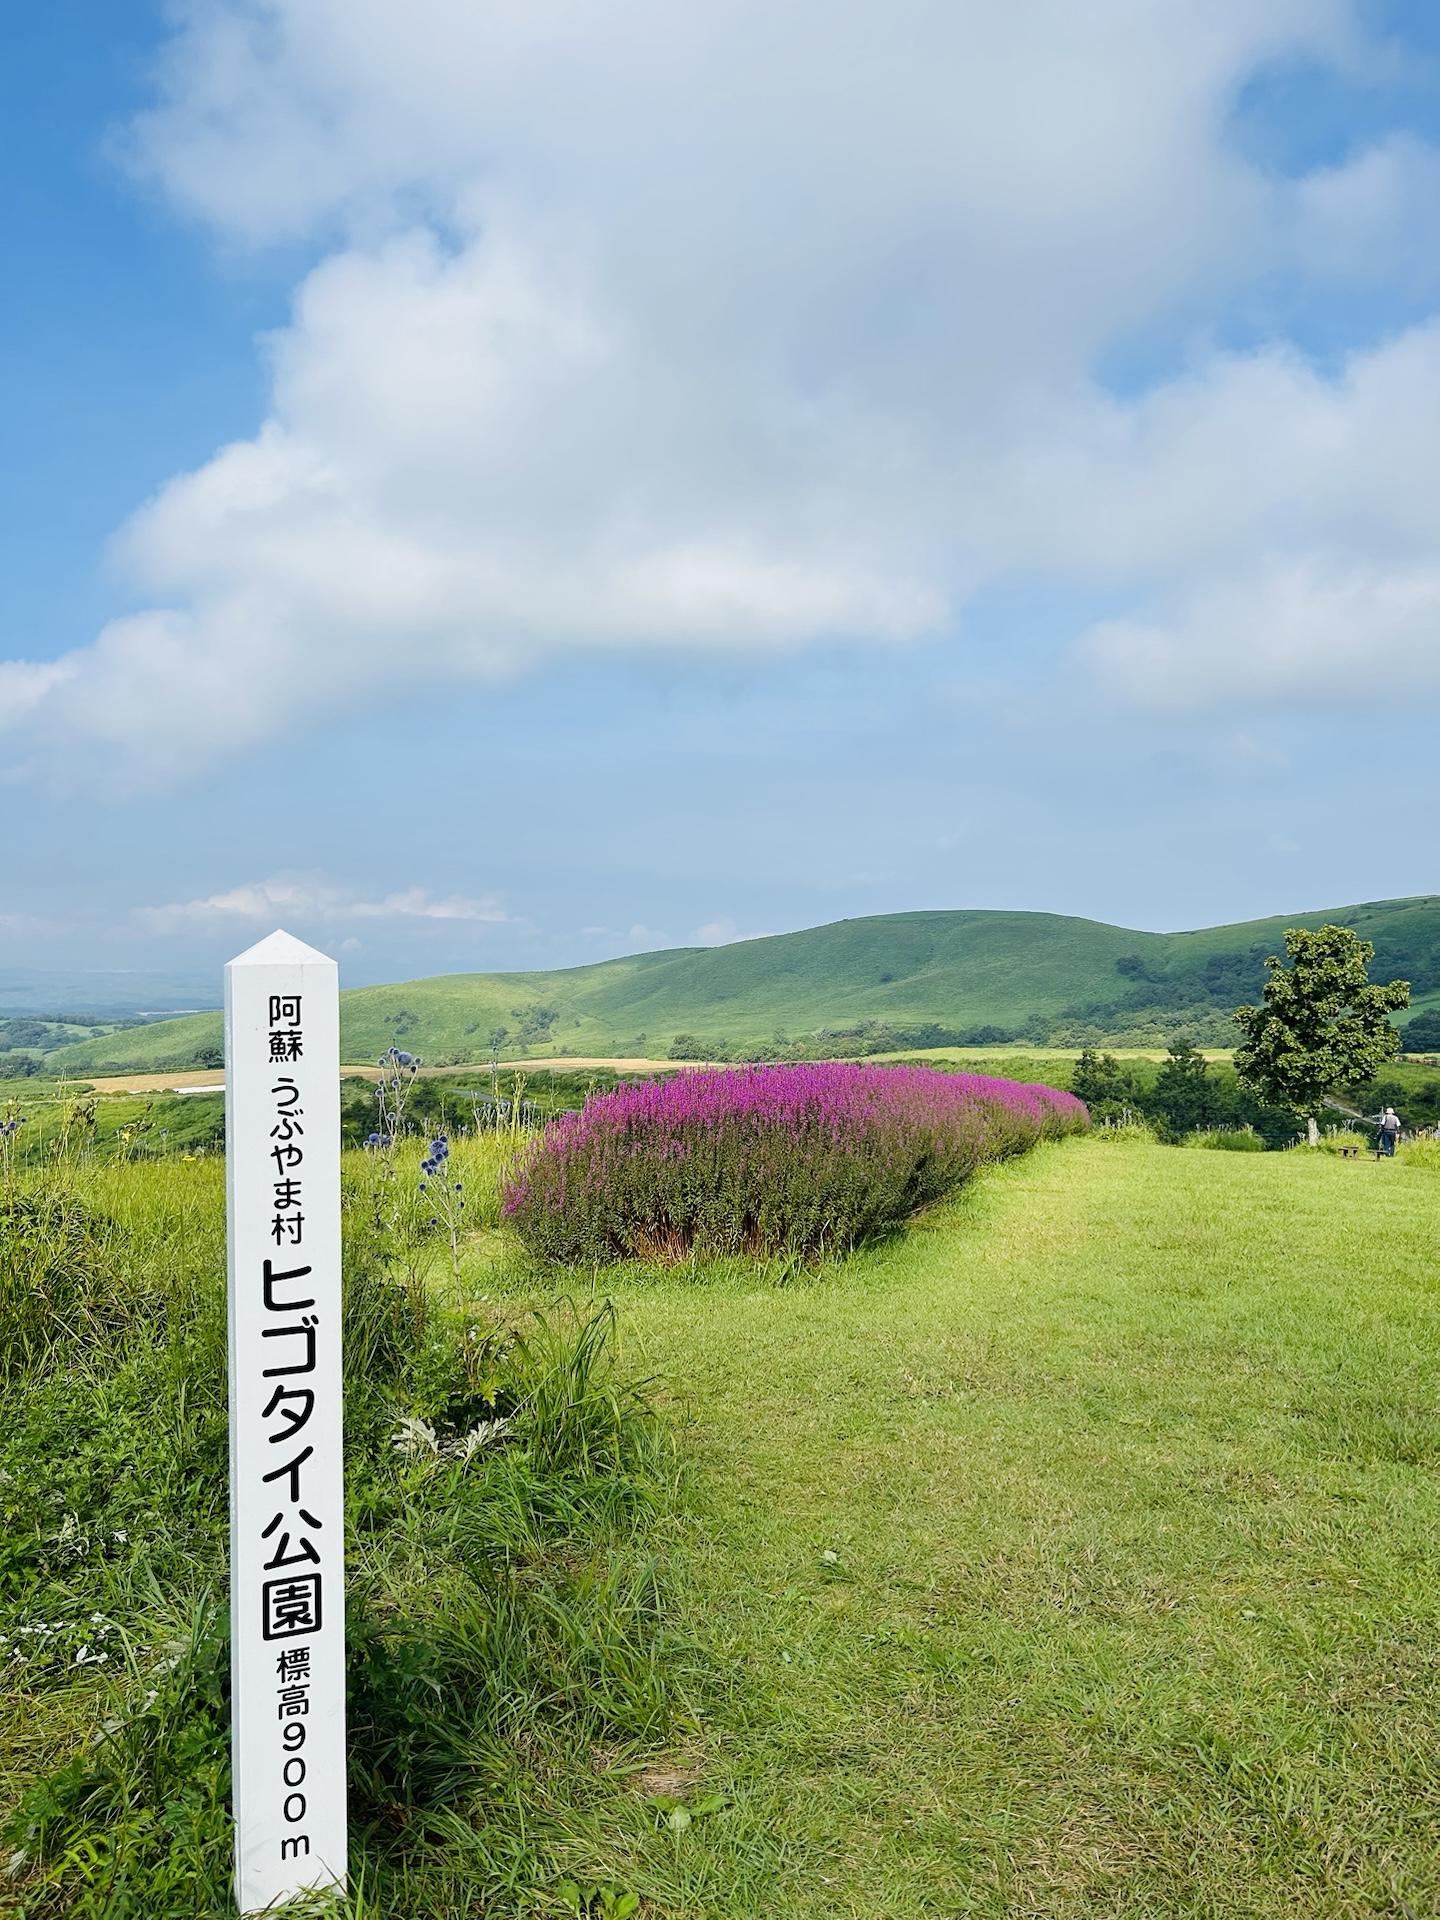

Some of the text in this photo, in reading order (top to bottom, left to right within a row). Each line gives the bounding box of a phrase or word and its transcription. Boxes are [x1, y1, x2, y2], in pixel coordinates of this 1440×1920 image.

[268, 995, 305, 1246] 阿蘇 うぶやま村
[261, 1259, 323, 1642] ヒゴタイ公園
[276, 1646, 311, 1861] 標高900m
